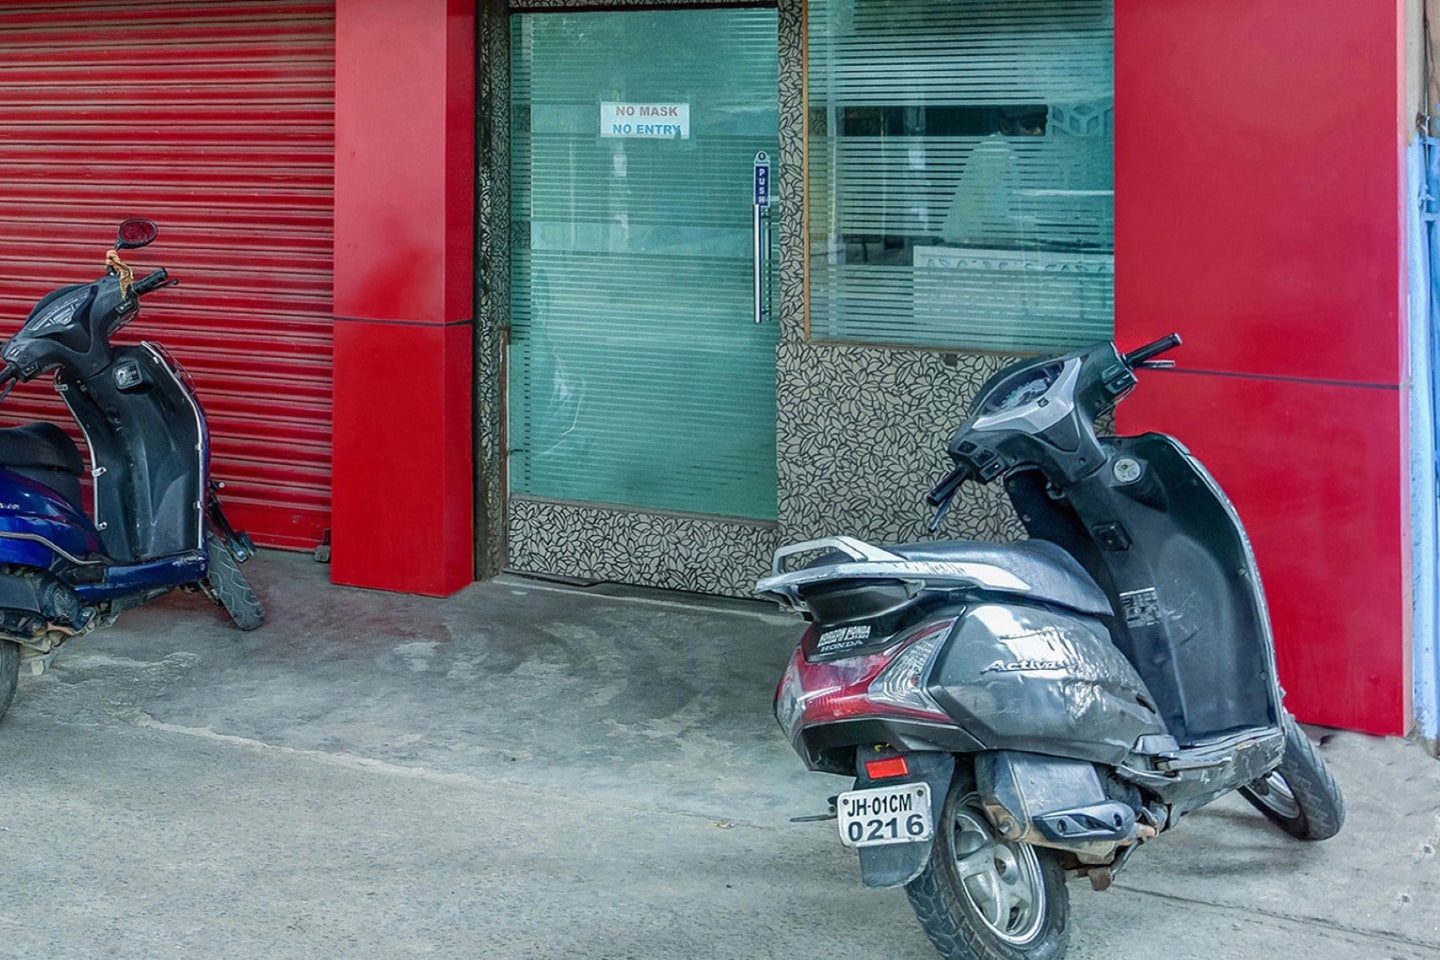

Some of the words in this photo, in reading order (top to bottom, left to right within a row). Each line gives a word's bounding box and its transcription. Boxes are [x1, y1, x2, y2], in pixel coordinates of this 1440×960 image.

[615, 105, 635, 117] NO
[639, 106, 678, 117] MASK
[613, 123, 632, 135] NO
[636, 123, 681, 136] ENTRY
[758, 168, 766, 204] PUSH
[820, 640, 864, 652] HONDA
[979, 659, 1058, 675] Activa
[847, 793, 912, 817] JH-01CM
[847, 813, 925, 842] 0216
